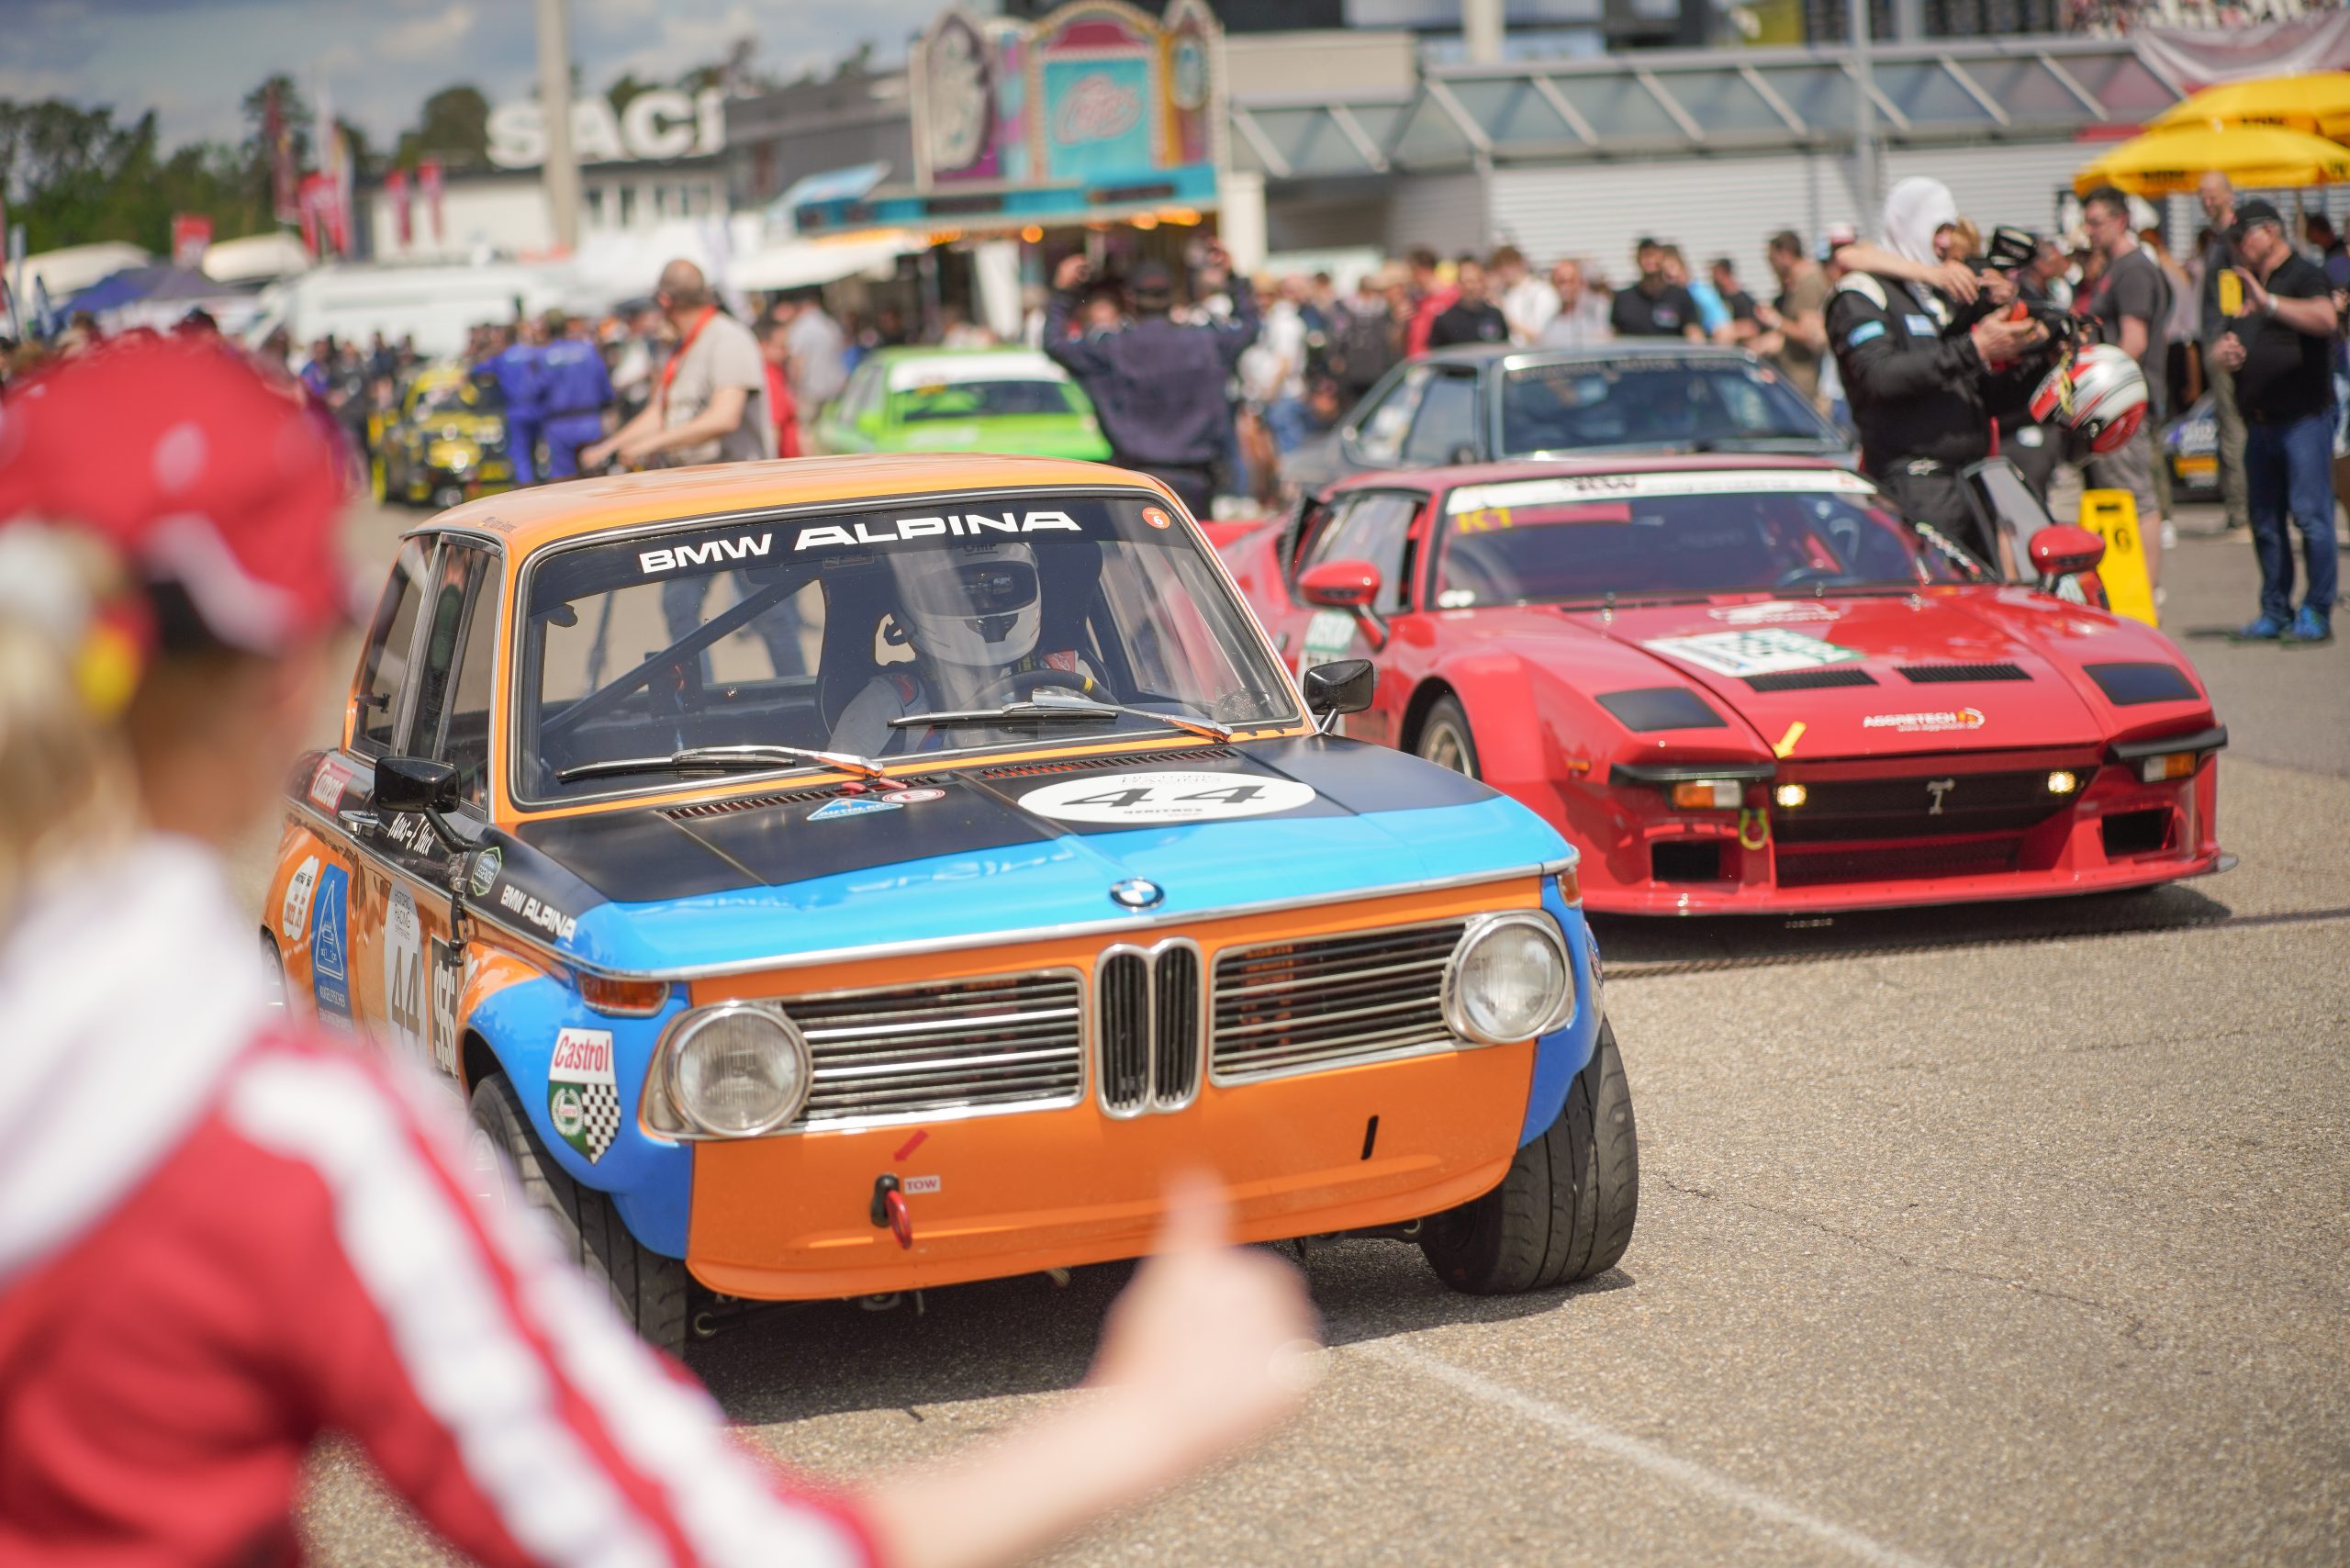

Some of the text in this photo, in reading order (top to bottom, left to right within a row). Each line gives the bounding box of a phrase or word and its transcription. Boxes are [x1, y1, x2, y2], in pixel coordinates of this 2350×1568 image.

[1153, 515, 1164, 525] 6
[1457, 508, 1514, 532] K1
[639, 511, 1082, 574] BMW ALPINA
[1060, 785, 1267, 808] 44
[394, 904, 411, 929] RACING
[500, 883, 577, 943] BMW ALPINA
[391, 946, 420, 1050] 44
[554, 1035, 610, 1073] Castrol
[906, 1179, 937, 1191] TOW
